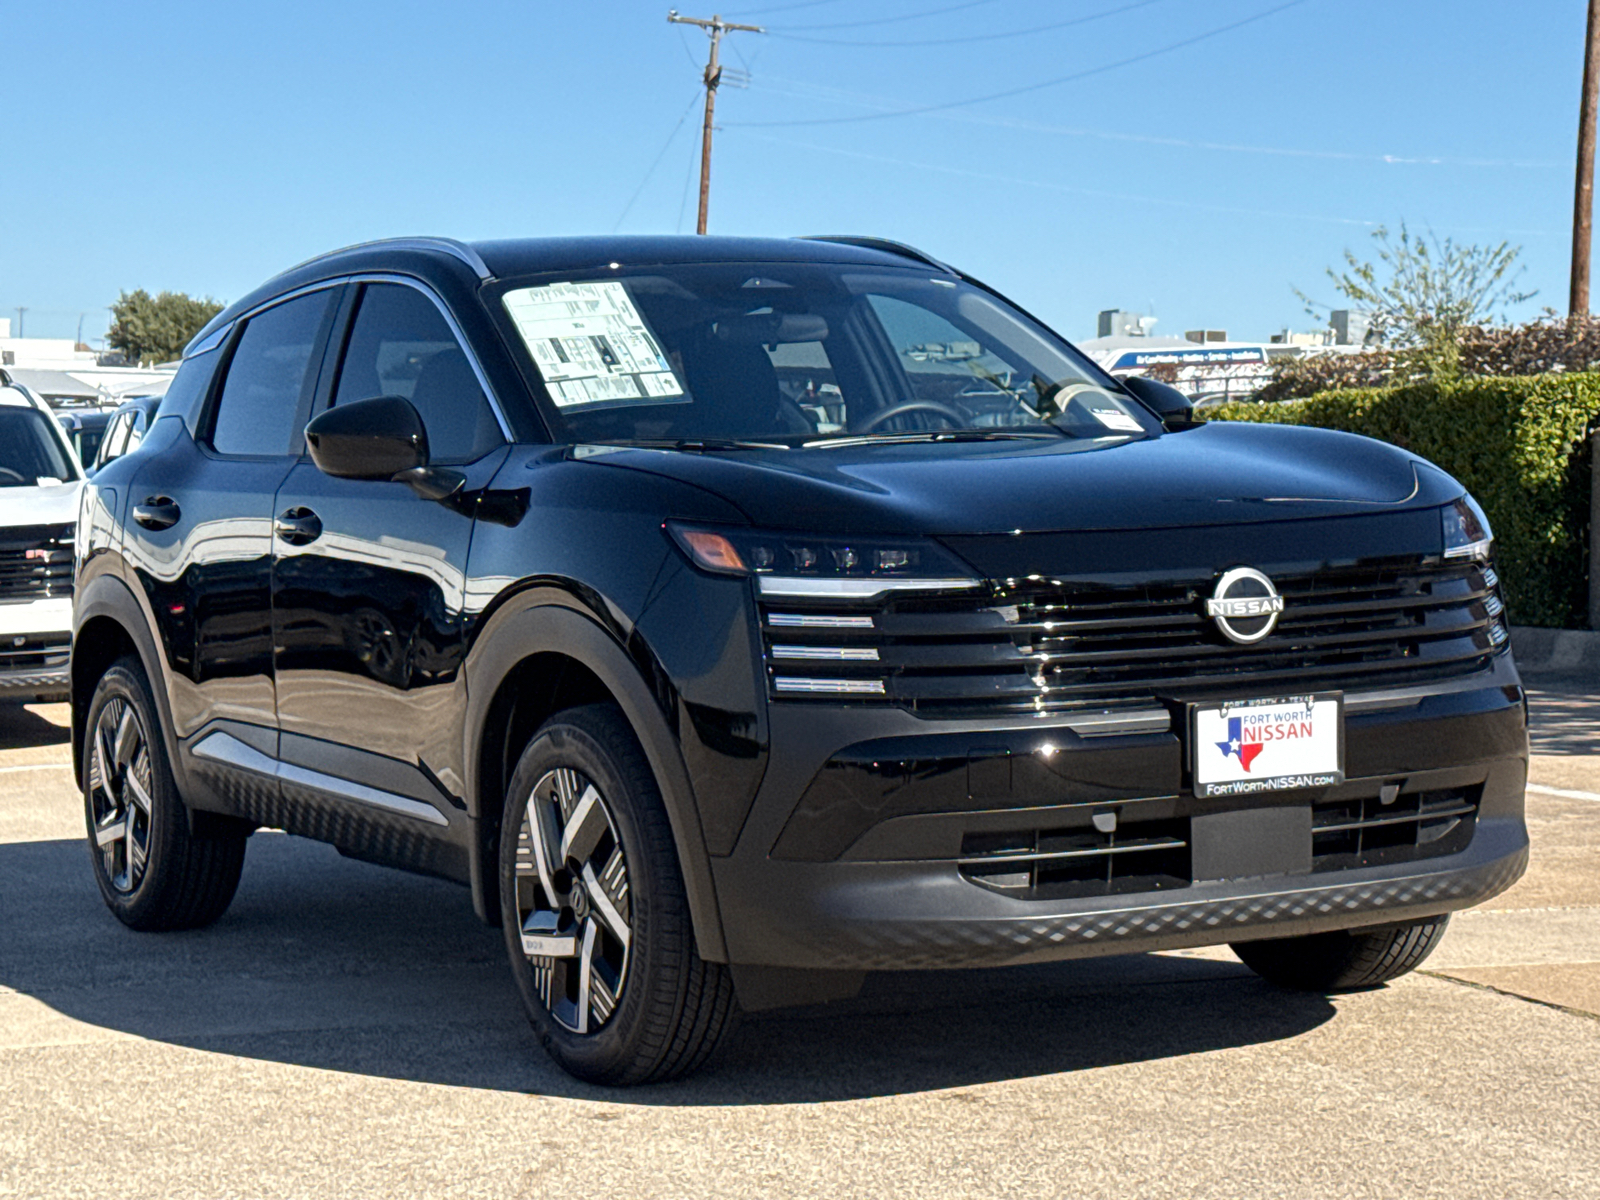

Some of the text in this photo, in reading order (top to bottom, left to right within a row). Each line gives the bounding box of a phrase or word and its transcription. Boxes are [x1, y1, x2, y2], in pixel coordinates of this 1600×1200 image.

[1209, 599, 1284, 615] NISSAN
[1243, 711, 1313, 724] FORT WORTH
[1243, 722, 1313, 743] NISSAN
